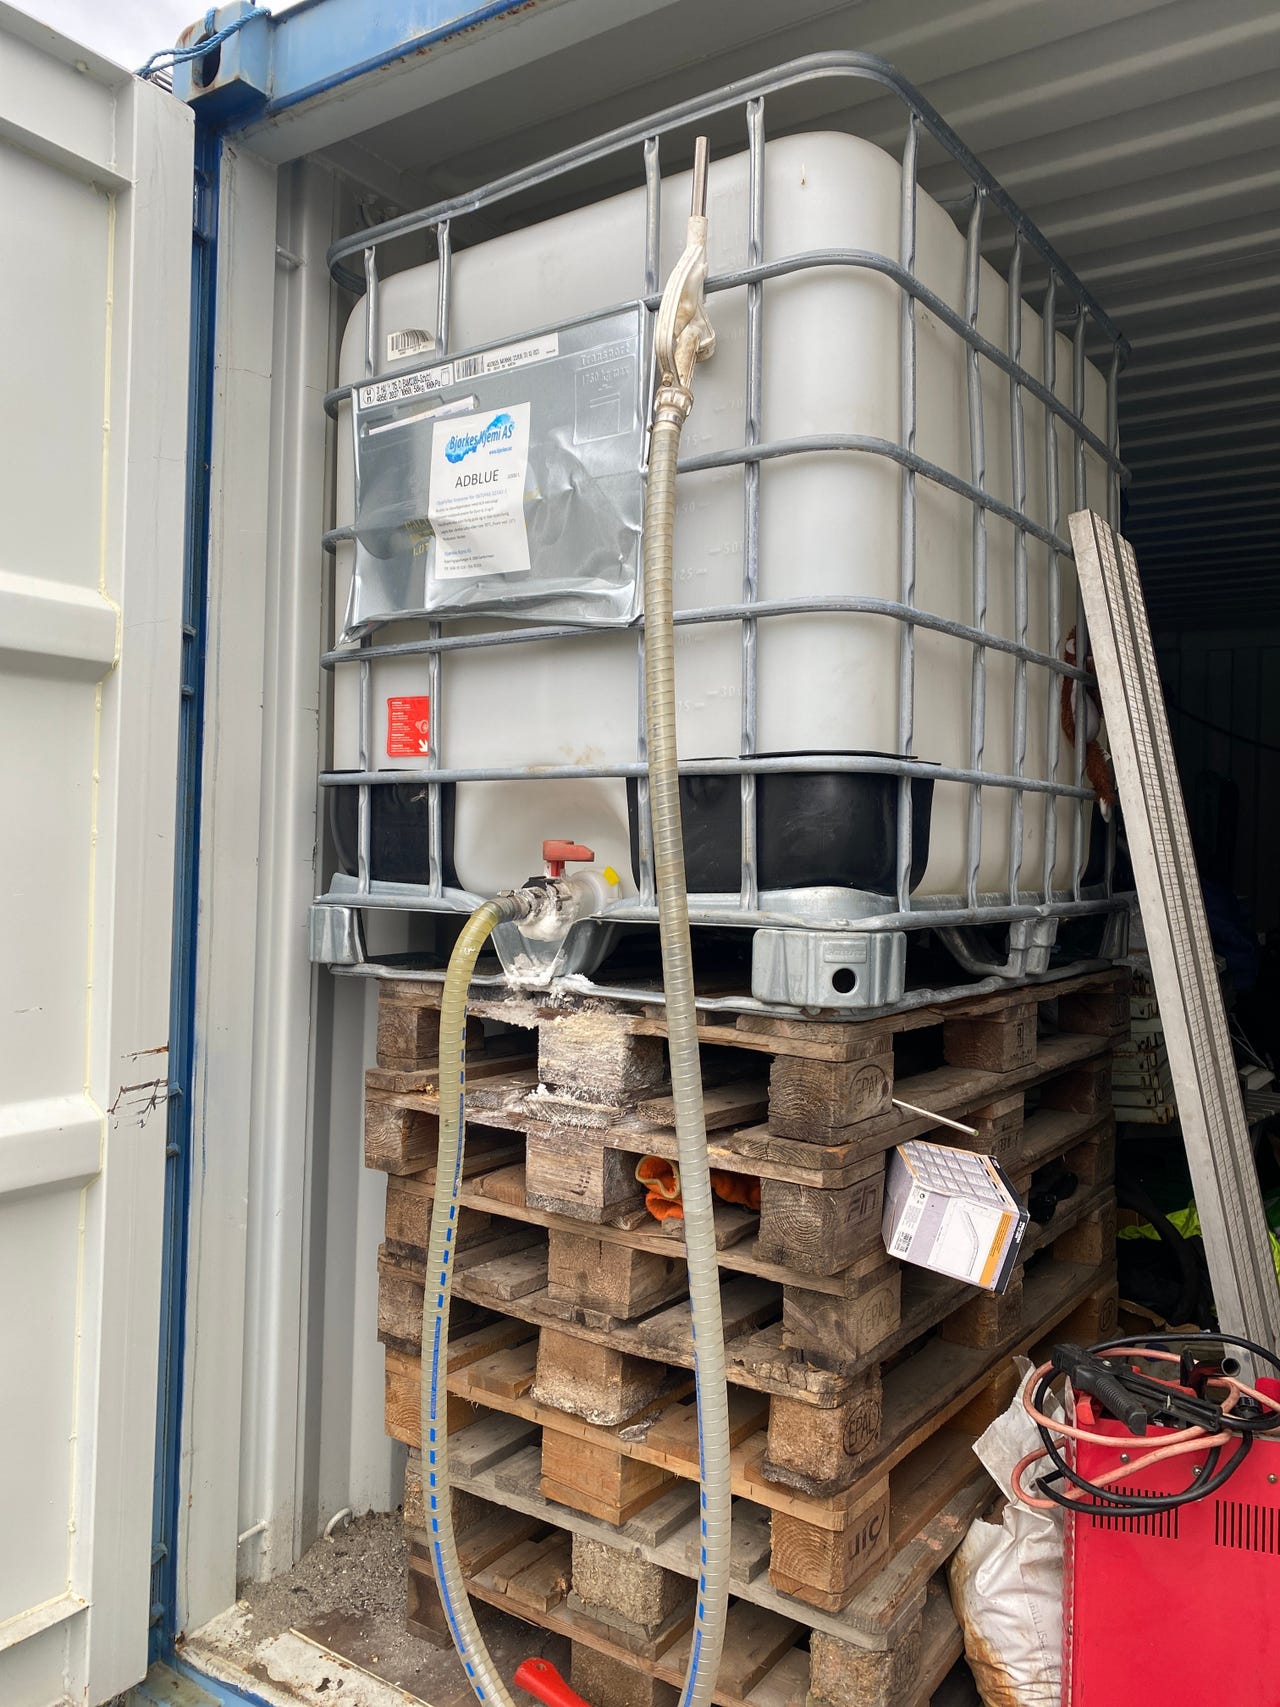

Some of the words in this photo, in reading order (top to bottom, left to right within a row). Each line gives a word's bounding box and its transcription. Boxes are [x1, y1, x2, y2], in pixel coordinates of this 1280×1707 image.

[502, 424, 513, 439] AS
[454, 469, 500, 488] ADBLUE
[849, 1412, 875, 1449] EPAL
